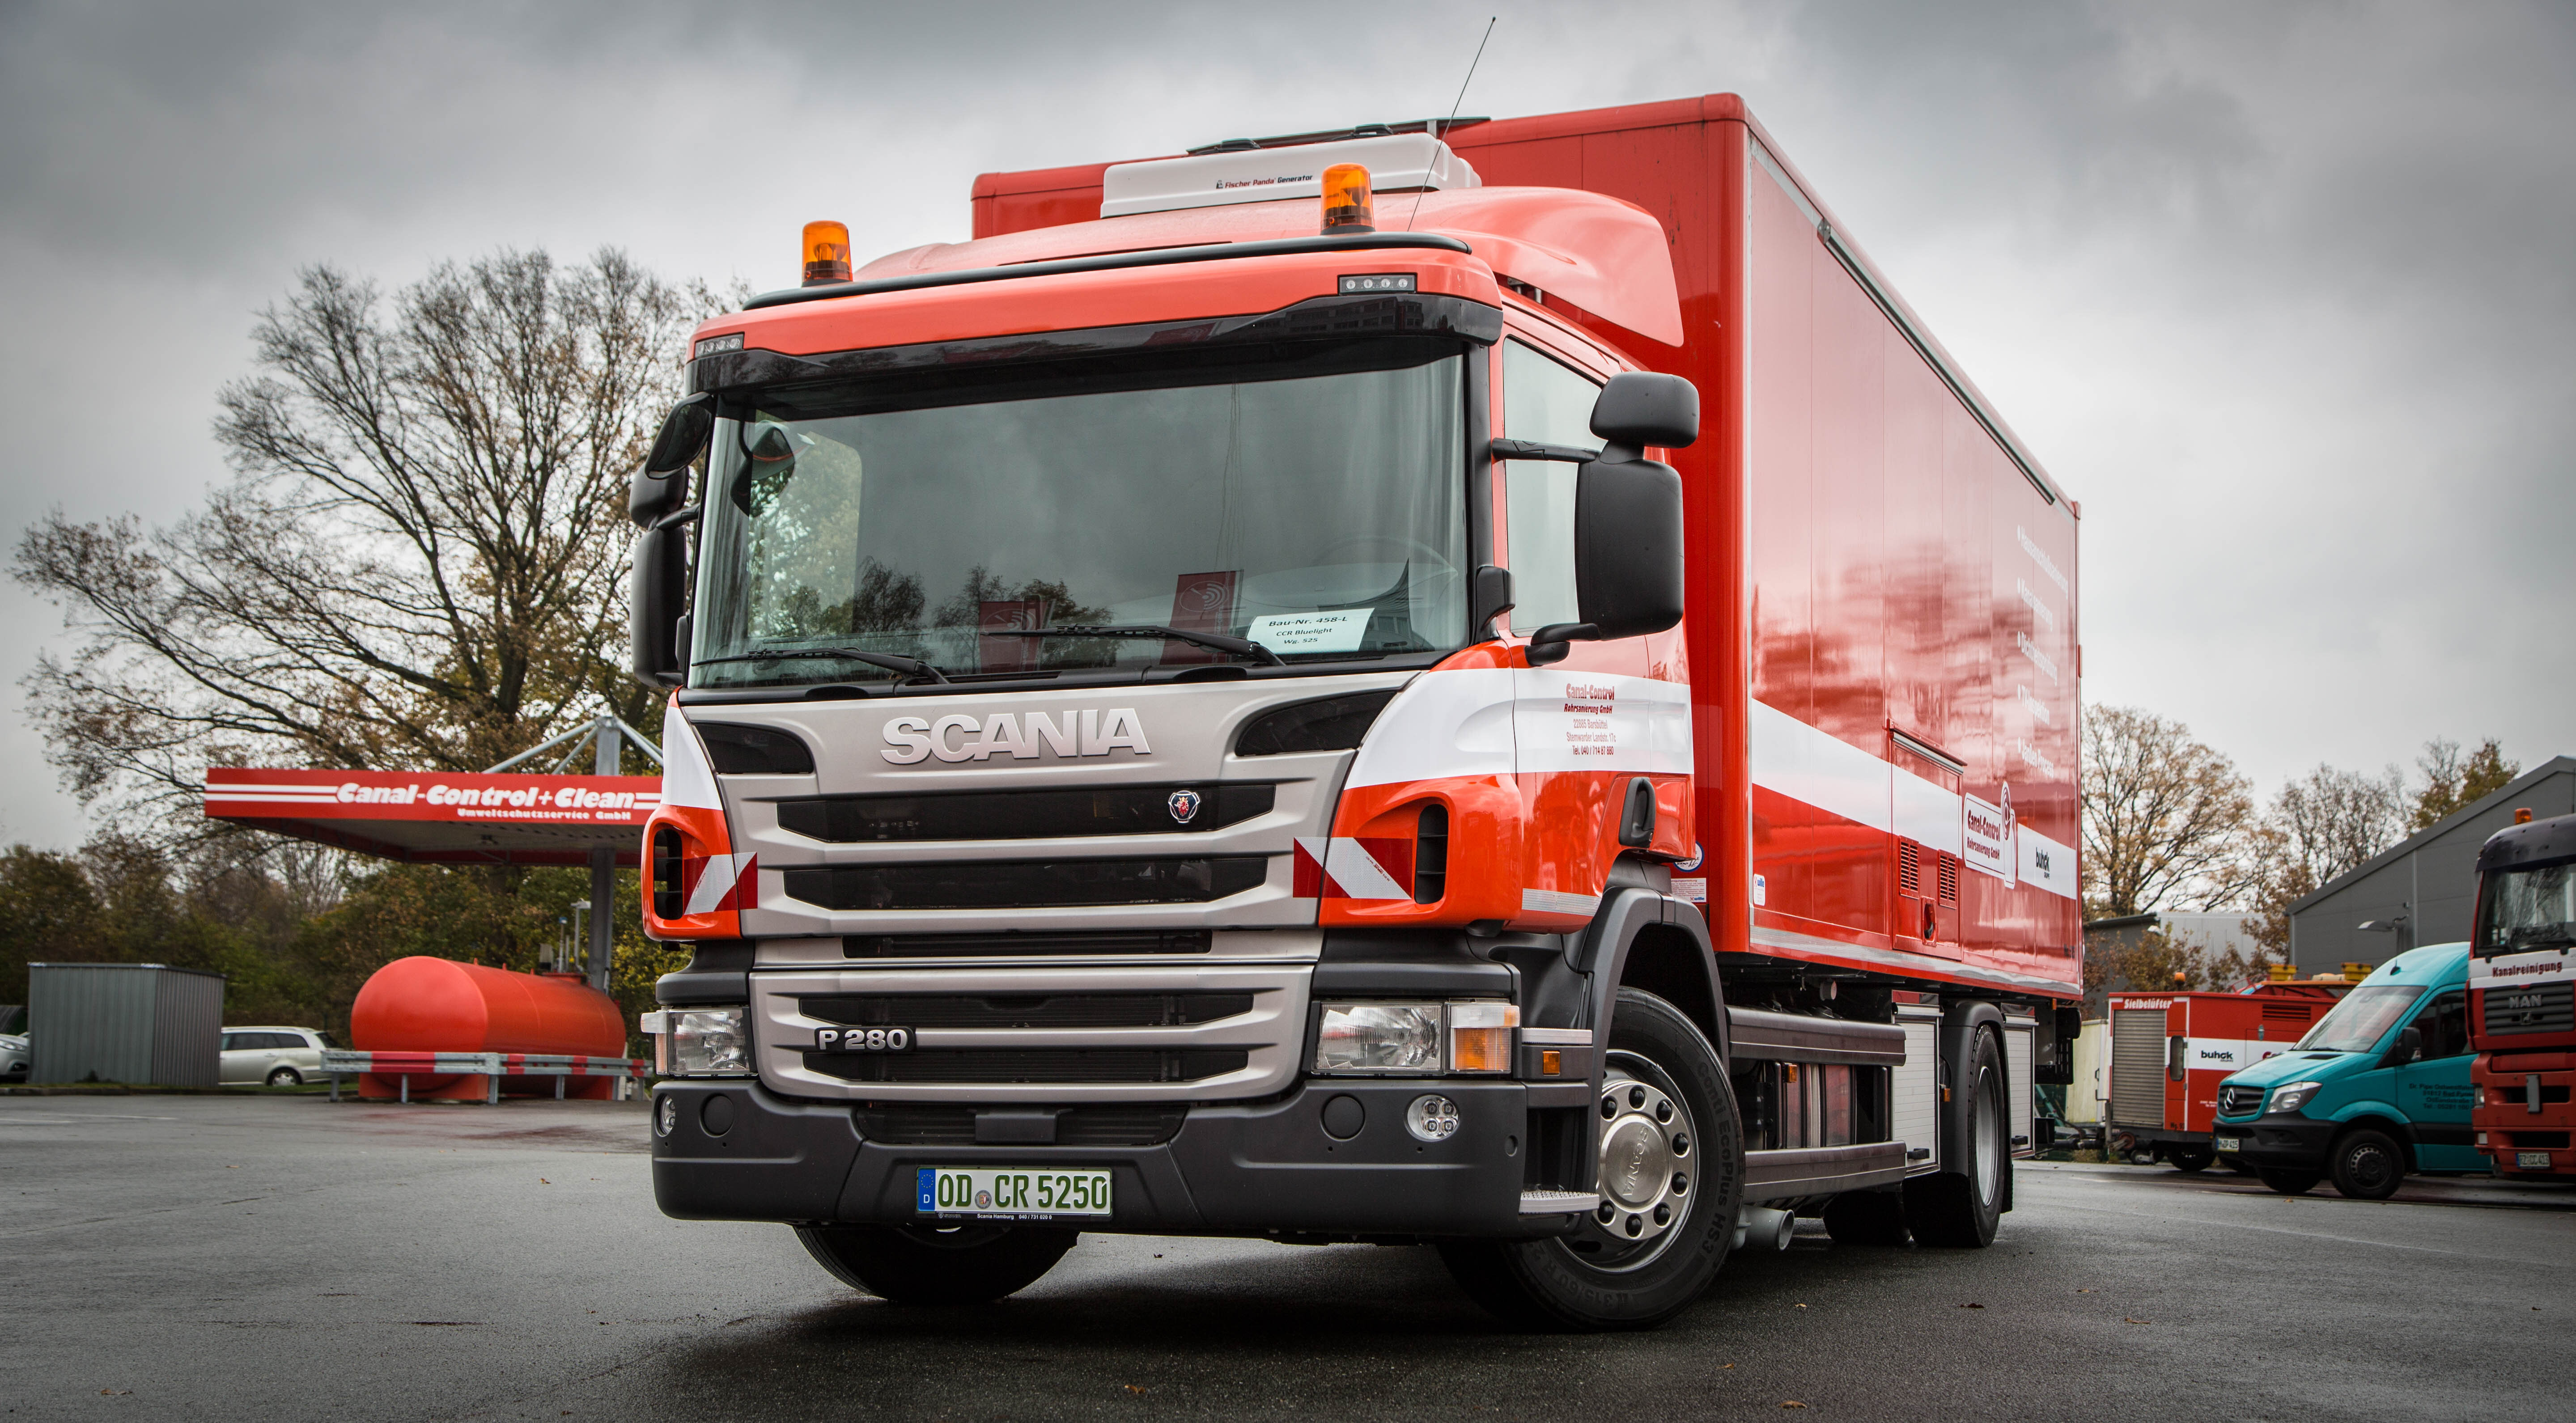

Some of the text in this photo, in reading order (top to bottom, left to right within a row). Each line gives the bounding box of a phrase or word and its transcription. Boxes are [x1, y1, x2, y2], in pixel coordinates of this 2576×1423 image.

[1277, 175, 1313, 183] Generator
[1566, 683, 1614, 700] Canal-Control
[1564, 703, 1613, 715] Rohrsanierung GmbH
[1573, 719, 1608, 729] 22885 Barsbüttel
[880, 707, 1152, 765] SCANIA
[1566, 732, 1591, 742] Stemwarder
[1593, 733, 1608, 742] Landstr.
[1601, 746, 1605, 755] 87
[457, 808, 631, 820] Umweltschutzservice GmbH
[1968, 809, 2000, 842] Canal-Control
[1967, 836, 2000, 860] Rohrsanierung GmbH
[2492, 961, 2563, 978] Kanalreinigung
[2124, 998, 2173, 1009] Sielbelüfter
[2509, 994, 2542, 1009] MAN
[819, 1029, 908, 1050] P 280
[1699, 1061, 1727, 1115] Conti
[1622, 1126, 1649, 1195] SCANIA
[1718, 1119, 1733, 1206] EcoPlus
[923, 1194, 930, 1203] D
[938, 1174, 1107, 1208] OD CR 5250
[1701, 1212, 1726, 1255] HS3
